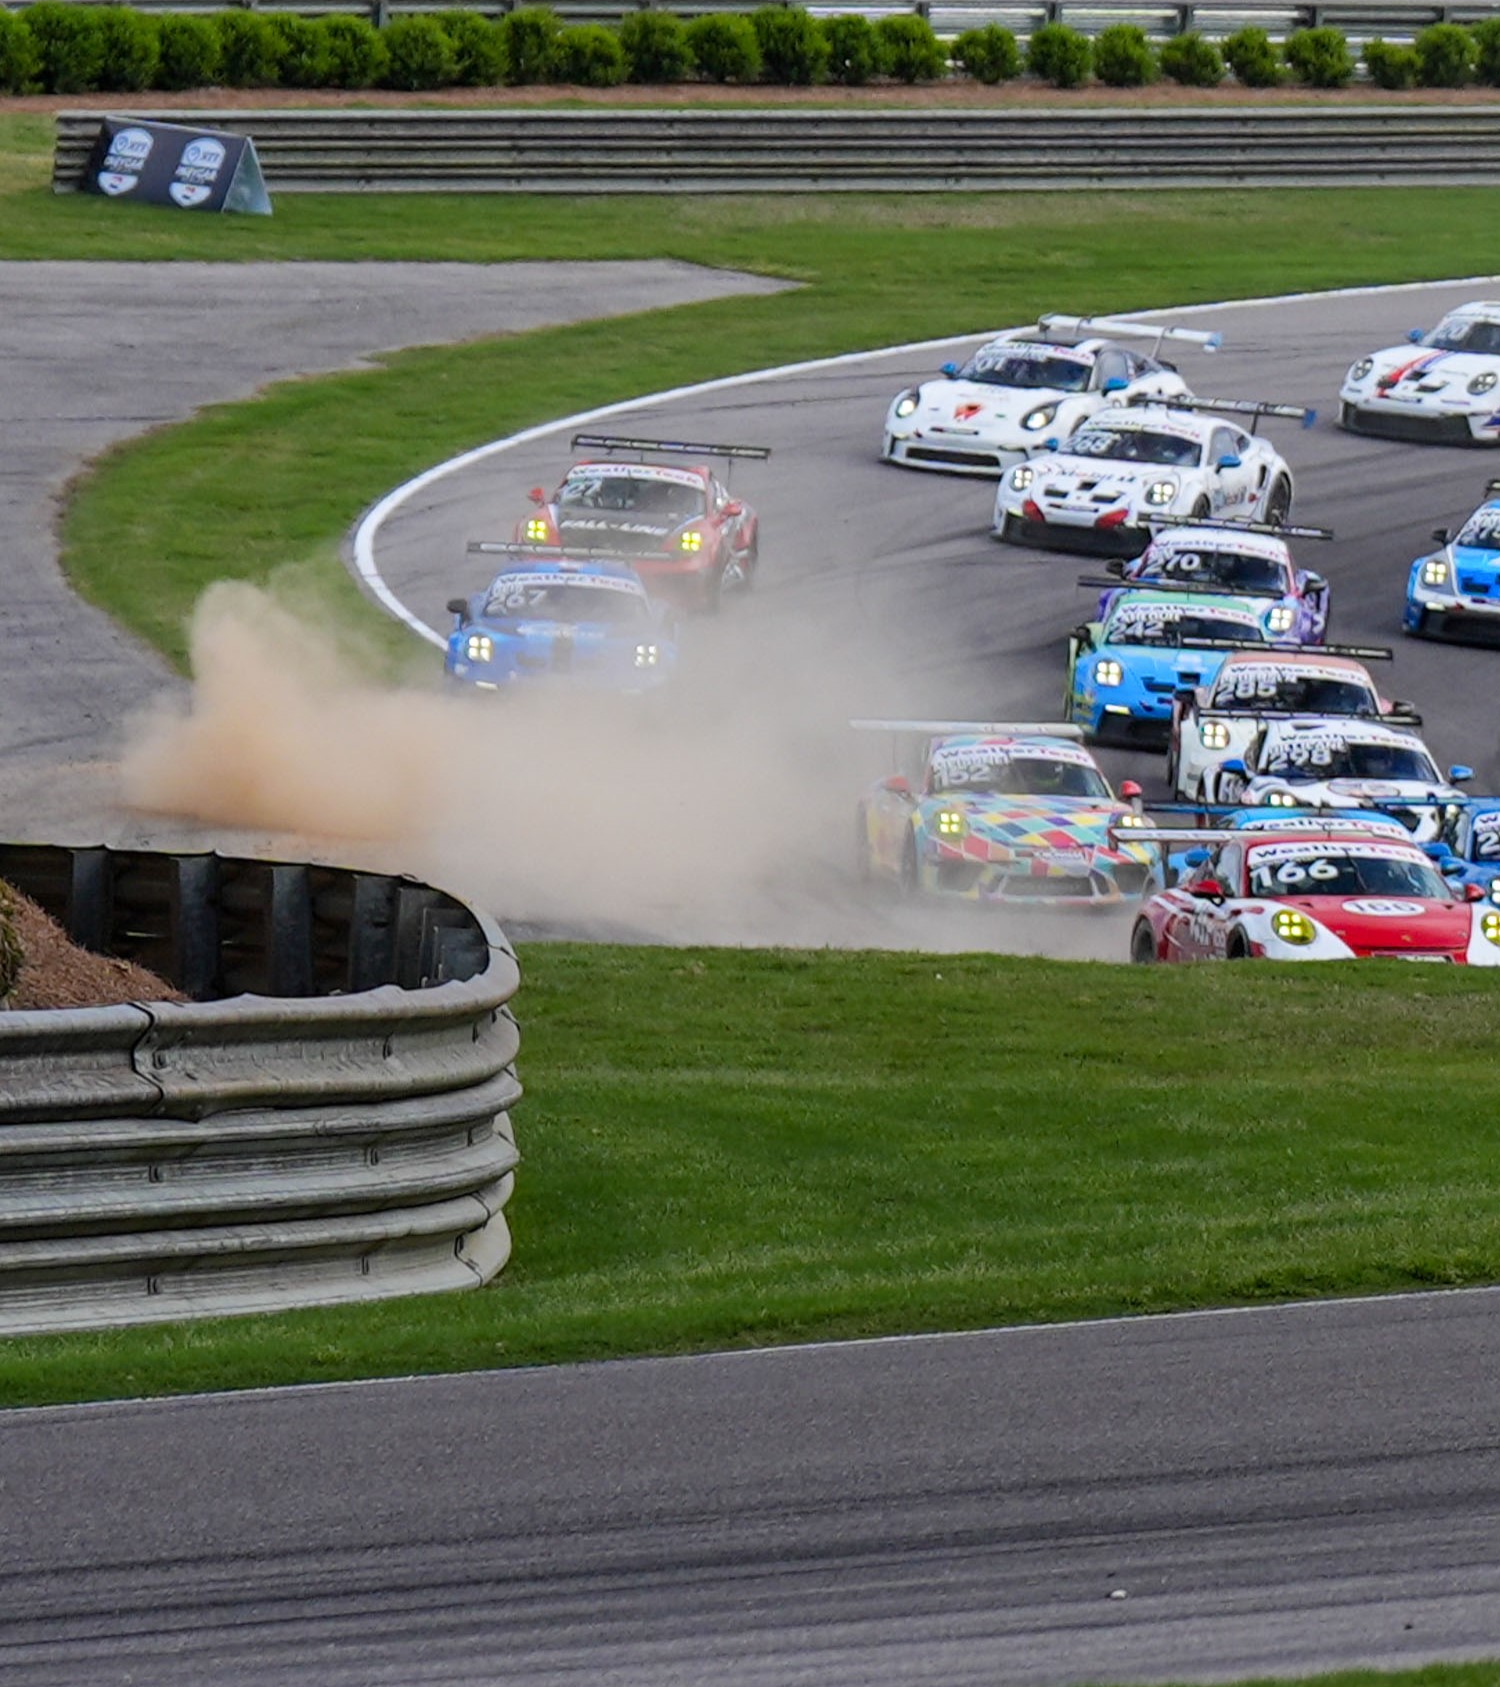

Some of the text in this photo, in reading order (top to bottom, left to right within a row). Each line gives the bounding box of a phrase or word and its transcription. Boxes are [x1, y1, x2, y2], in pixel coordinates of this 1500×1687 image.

[572, 467, 701, 484] WeatherTech
[499, 574, 639, 593] WeatherTech
[1121, 603, 1255, 623] WeatherTech
[1108, 620, 1165, 644] 242
[940, 747, 1088, 763] WeatherTech
[1268, 746, 1333, 773] 298
[1256, 844, 1426, 863] WeatherTech
[1250, 858, 1339, 888] 166
[1352, 901, 1417, 913] 166
